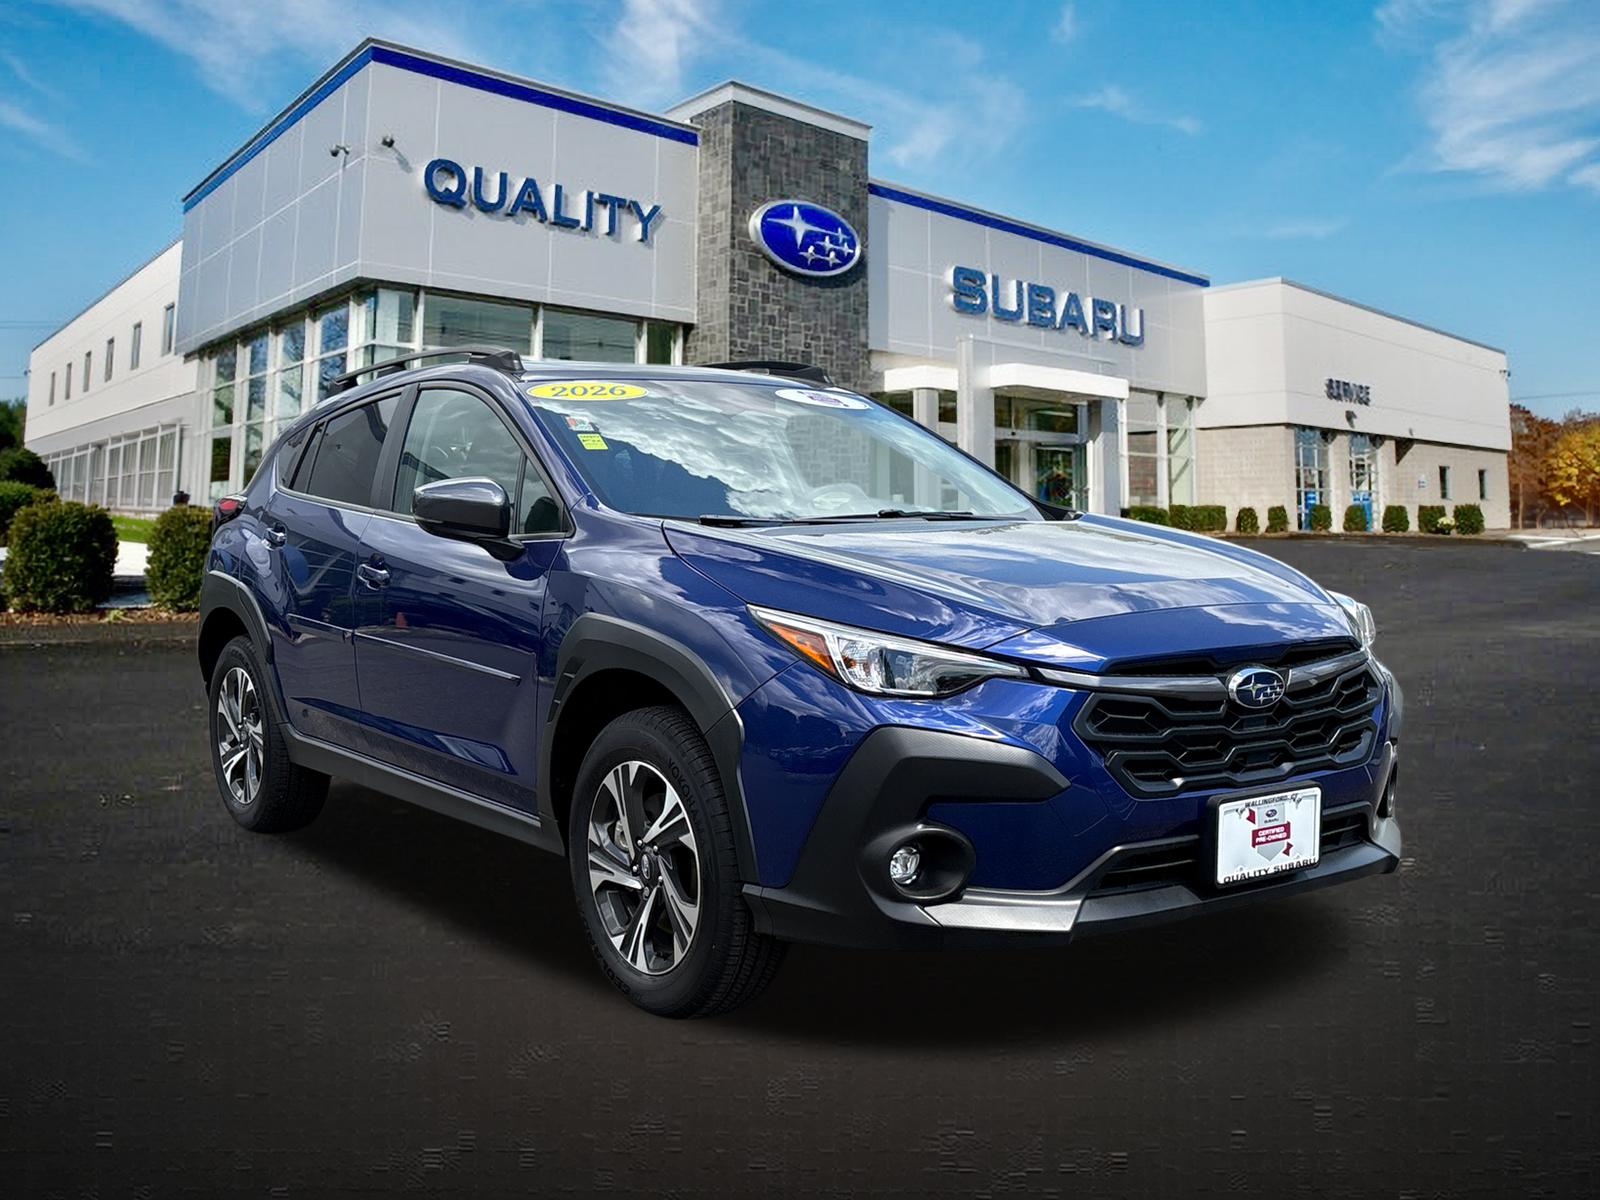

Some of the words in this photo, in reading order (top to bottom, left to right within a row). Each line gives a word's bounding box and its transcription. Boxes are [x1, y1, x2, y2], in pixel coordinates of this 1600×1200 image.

[424, 157, 662, 243] QUALITY
[949, 264, 1146, 347] SUBARU
[551, 385, 627, 398] 2026
[1325, 377, 1371, 407] SERVICE
[1256, 832, 1287, 843] PRE-OWNED
[1258, 827, 1284, 836] CERTIFIED
[1223, 867, 1270, 883] QUALITY
[1273, 857, 1316, 872] SUBARU
